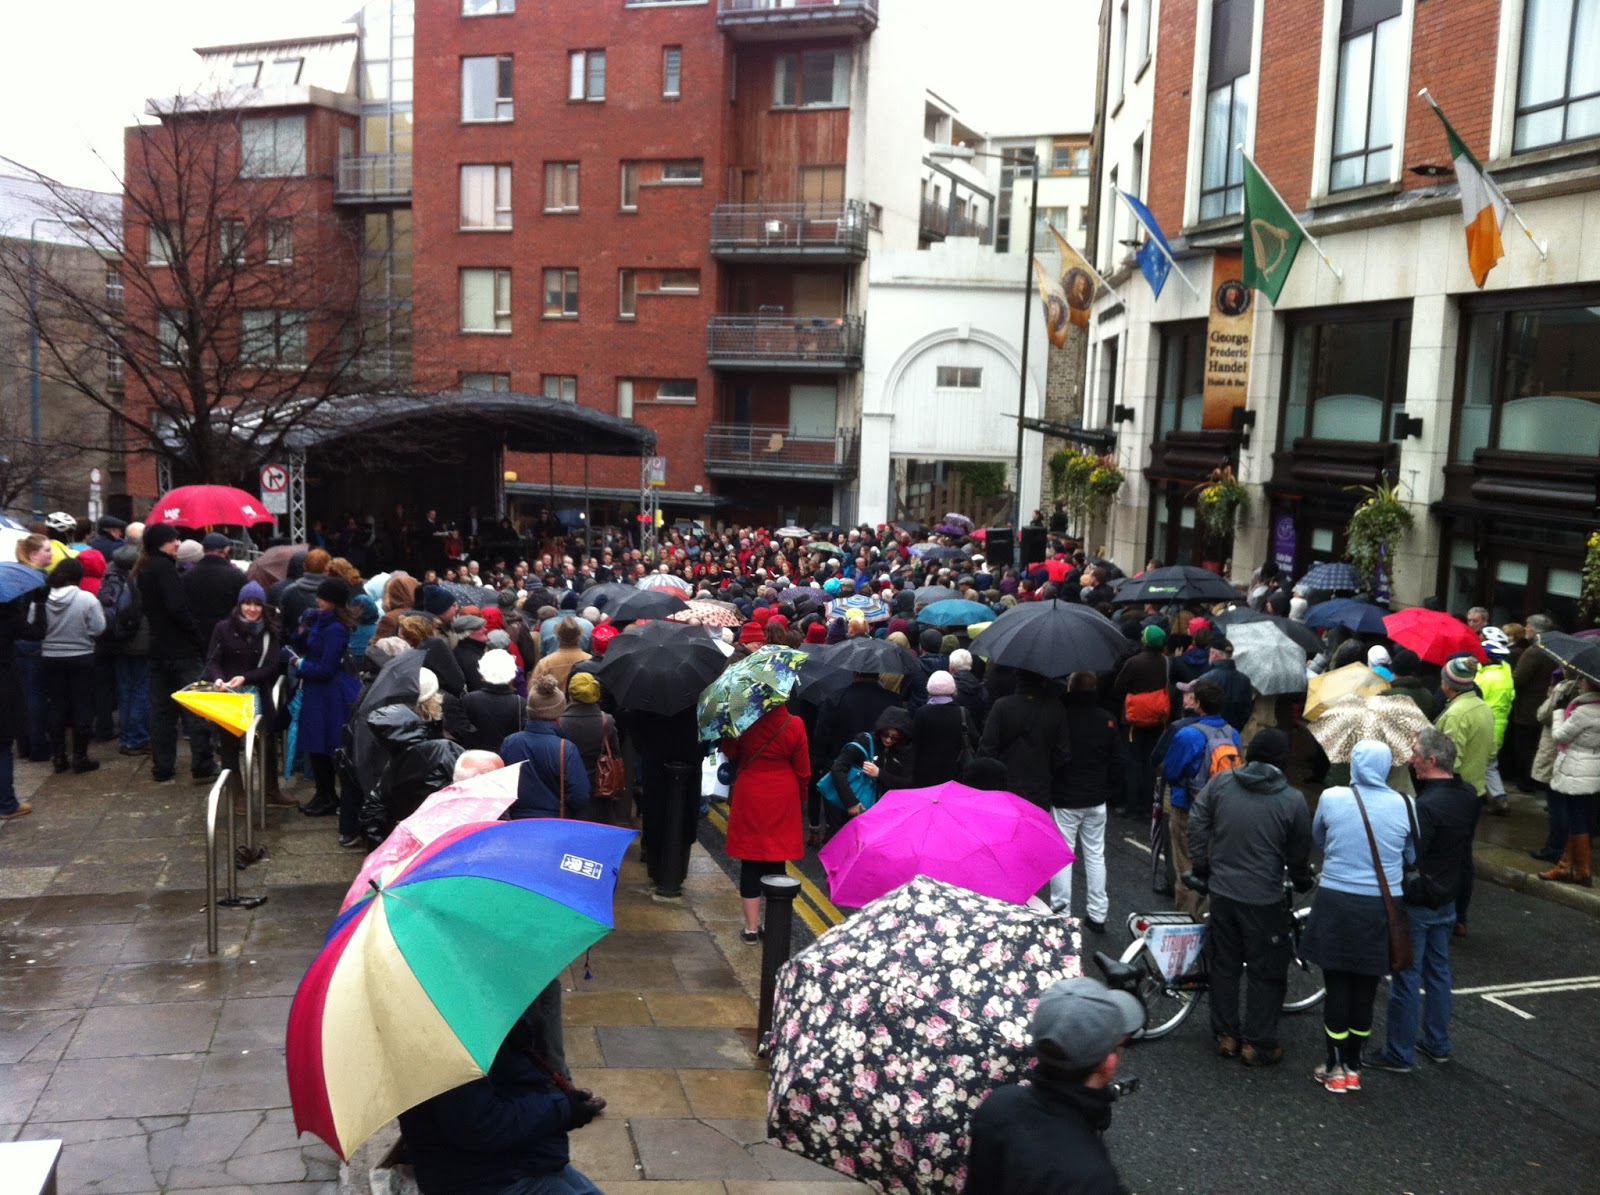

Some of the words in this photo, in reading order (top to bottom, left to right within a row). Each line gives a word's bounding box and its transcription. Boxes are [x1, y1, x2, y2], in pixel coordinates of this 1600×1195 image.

[1210, 330, 1249, 346] George
[1209, 346, 1248, 358] Frederic
[1208, 360, 1247, 373] Handel
